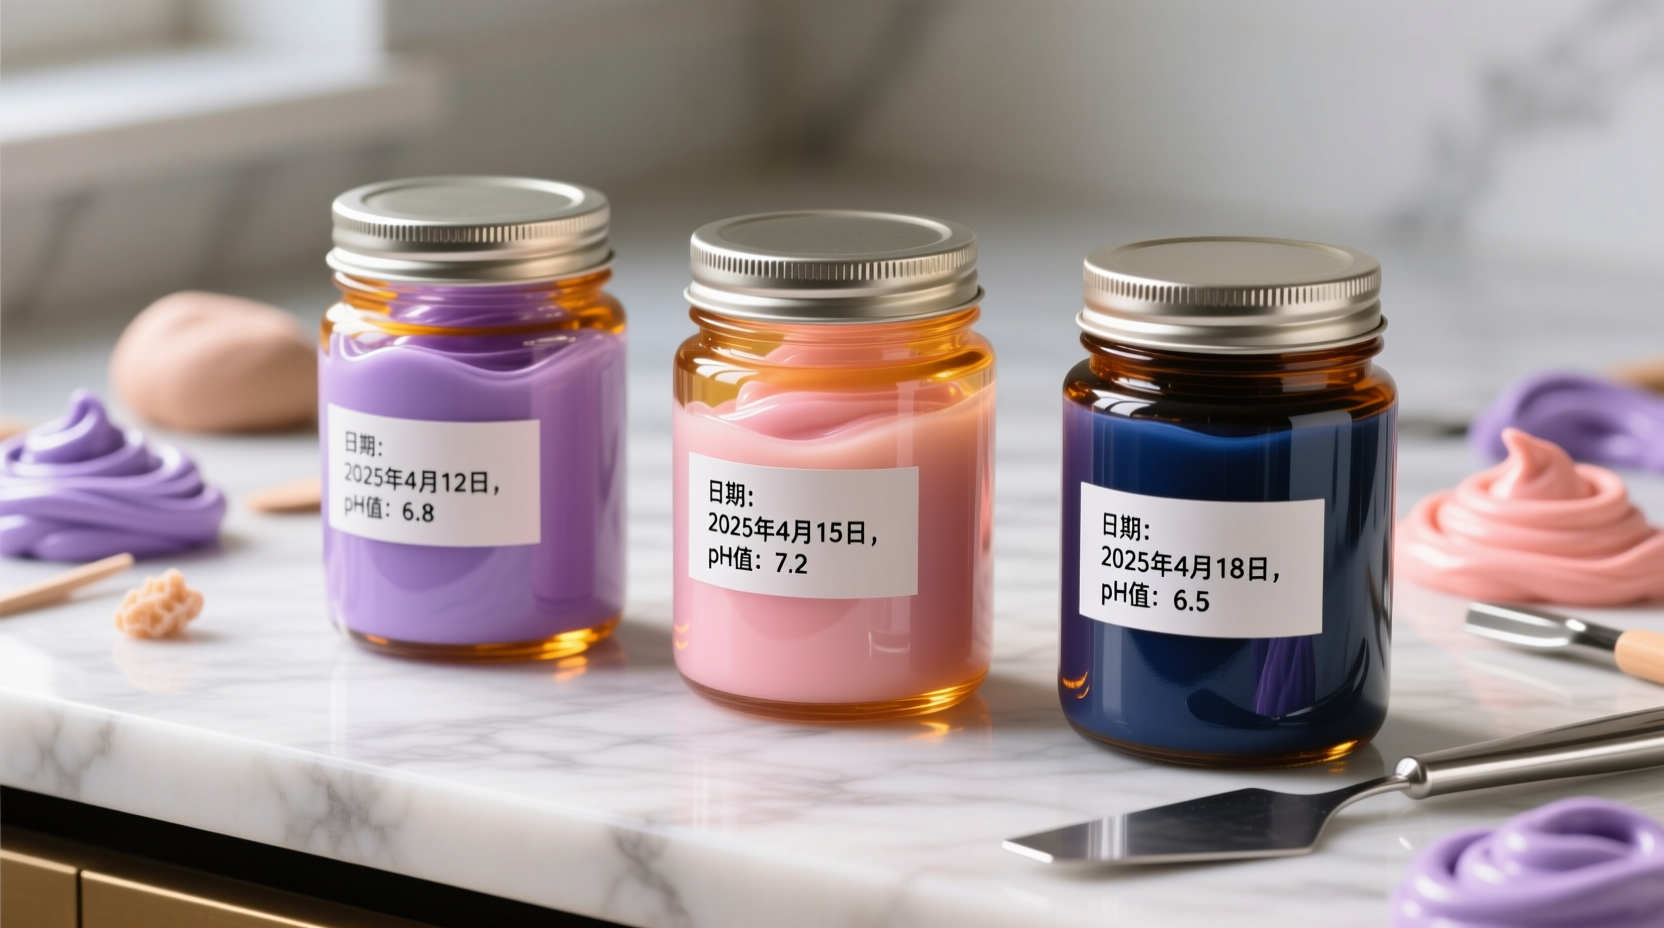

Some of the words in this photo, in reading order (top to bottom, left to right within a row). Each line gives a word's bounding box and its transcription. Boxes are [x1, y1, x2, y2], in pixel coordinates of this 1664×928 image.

[345, 430, 383, 458] 日期：
[344, 462, 500, 496] 2025年4月12日，
[709, 479, 753, 508] 日期：
[708, 511, 878, 547] 2025年4月15日，
[1103, 512, 1150, 541] 日期：
[1101, 545, 1280, 583] 2025年4月18日，
